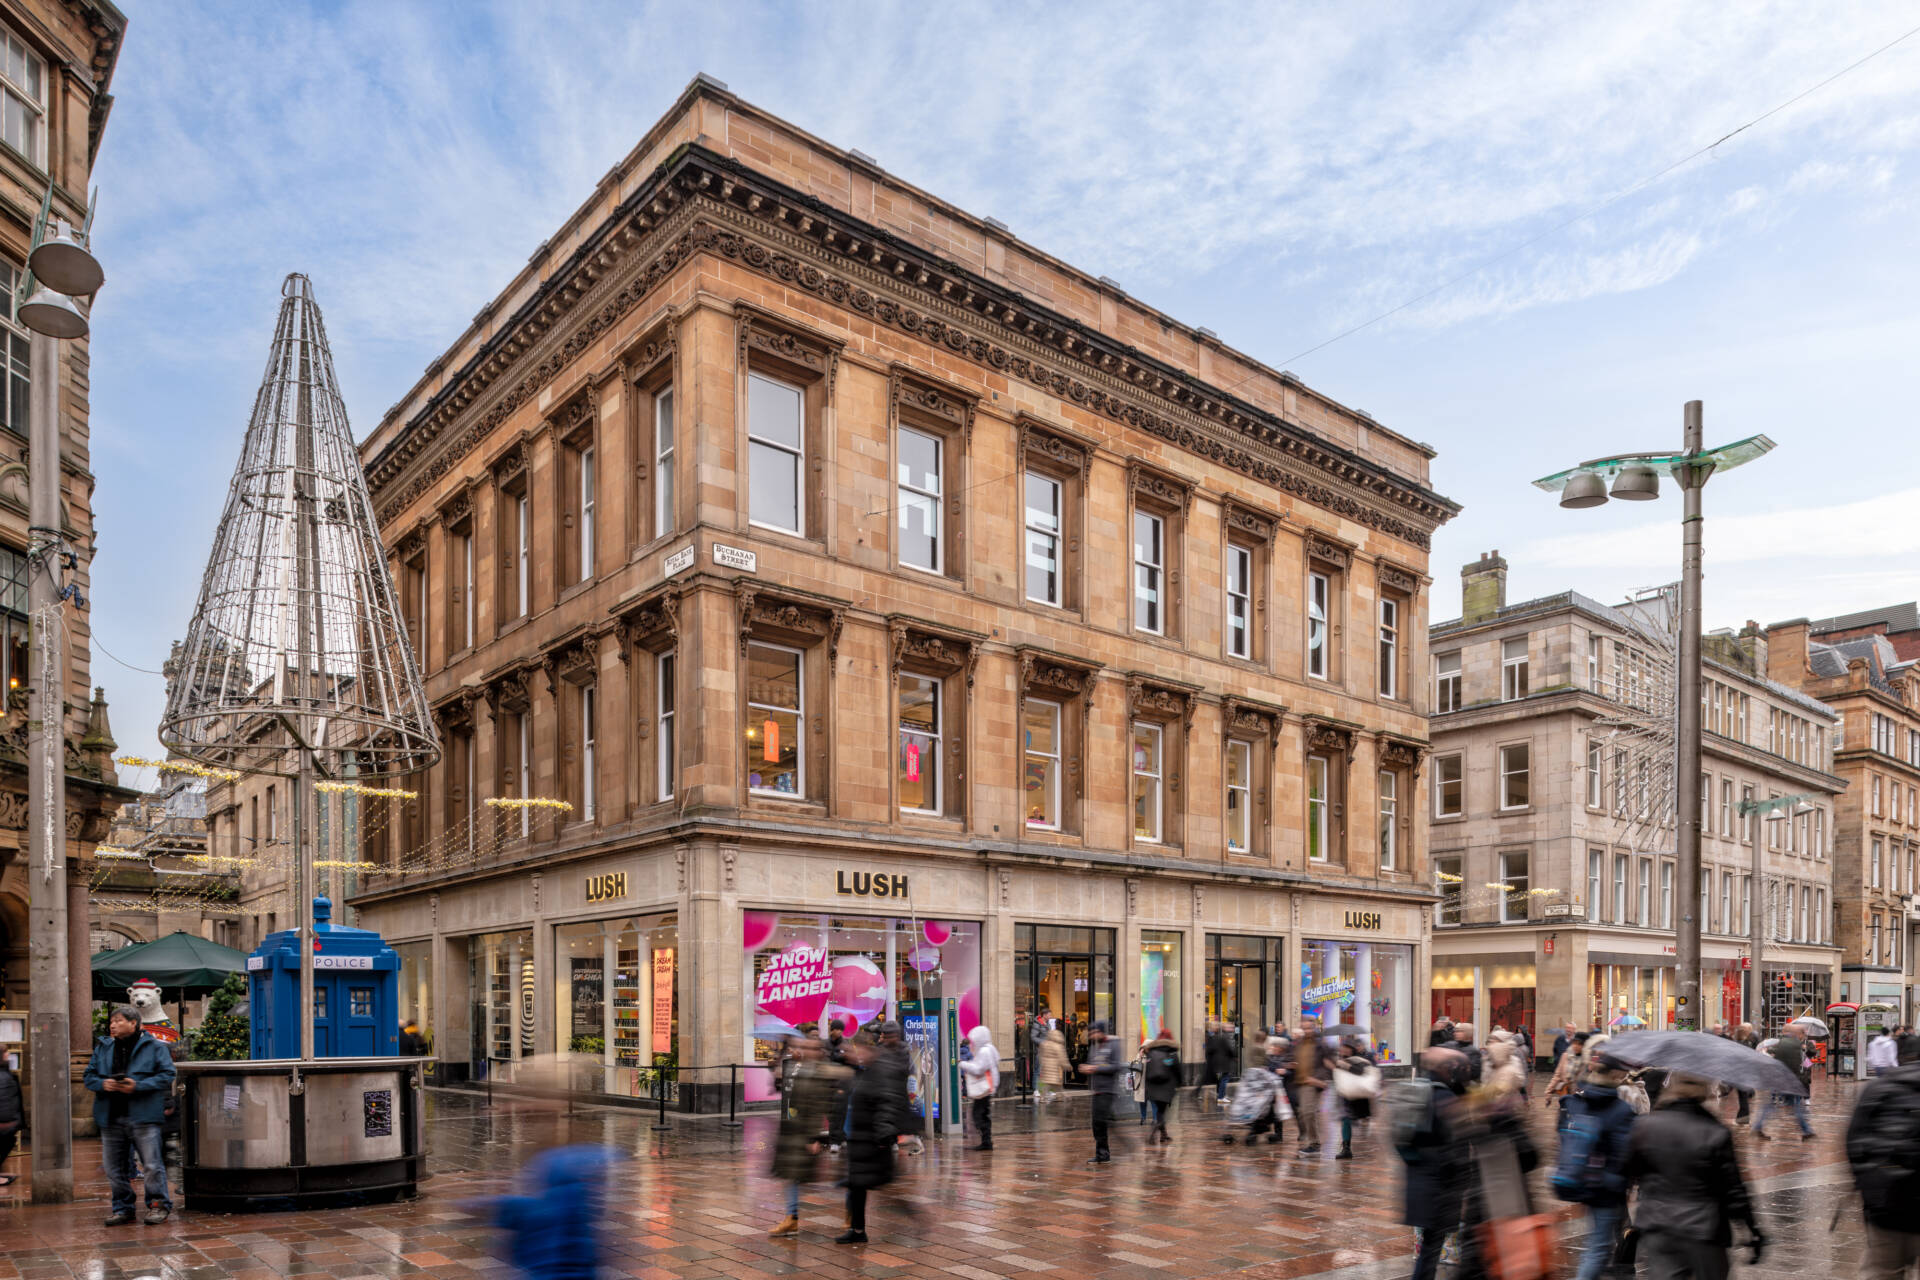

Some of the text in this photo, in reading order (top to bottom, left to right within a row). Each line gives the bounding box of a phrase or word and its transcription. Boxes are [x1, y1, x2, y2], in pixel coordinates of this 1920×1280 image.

[716, 545, 754, 560] BUCHANAN
[721, 553, 749, 566] STREET
[586, 872, 627, 902] LUSH
[836, 870, 908, 898] LUSH
[1344, 911, 1381, 929] LUSH
[315, 958, 366, 968] POLICE
[767, 948, 826, 970] SNOW
[758, 964, 833, 988] FAIRY HAS
[758, 978, 833, 1004] LANDED
[1304, 978, 1355, 999] CHRISTMAS
[905, 1020, 937, 1029] Chrismas
[905, 1032, 930, 1044] by tran
